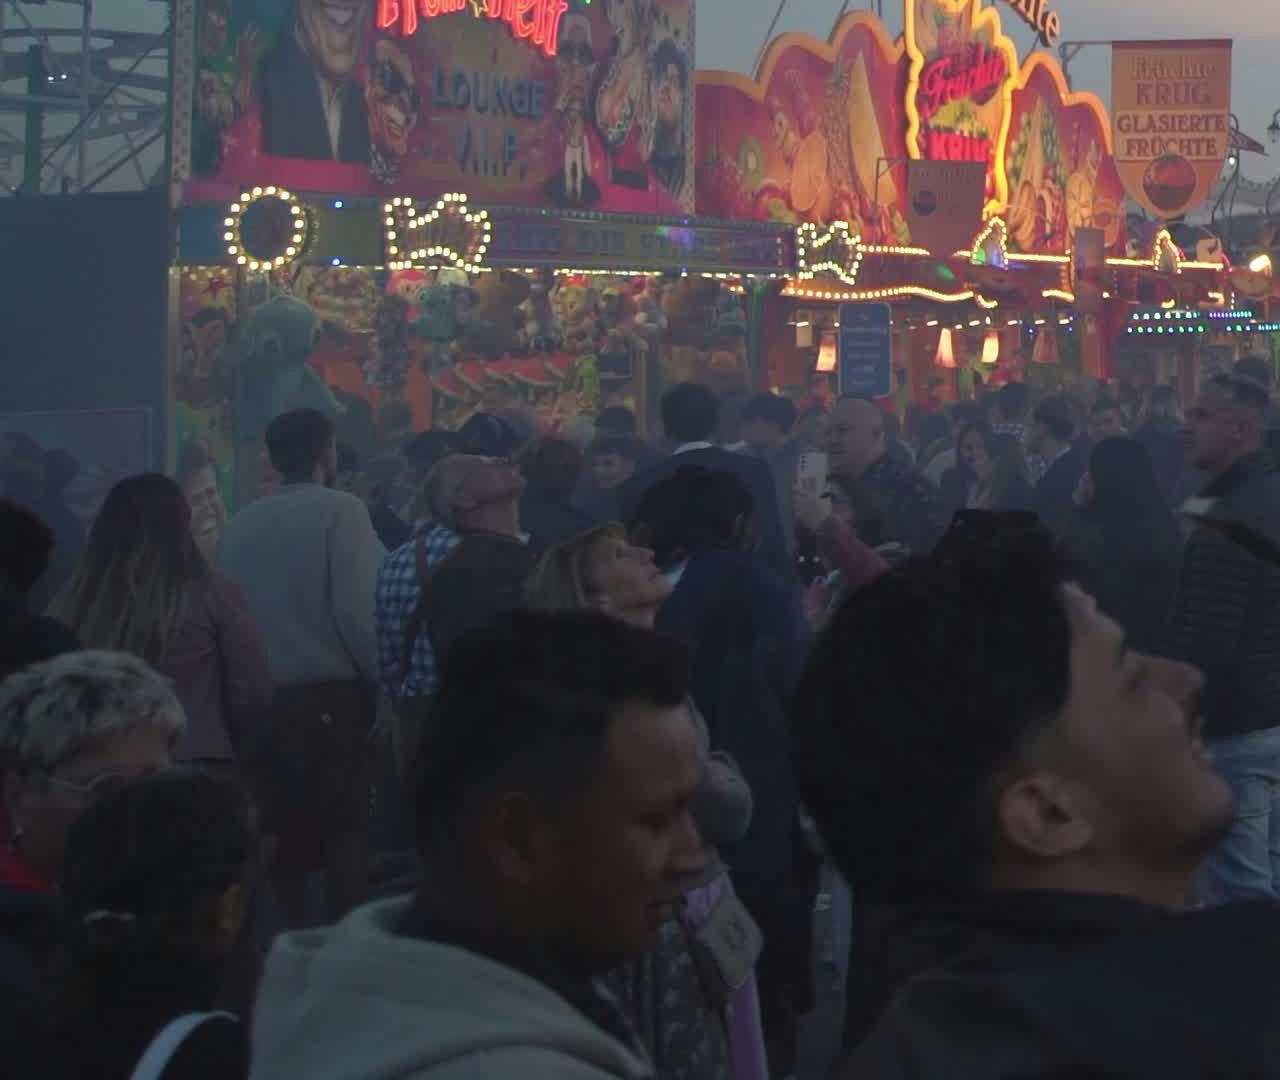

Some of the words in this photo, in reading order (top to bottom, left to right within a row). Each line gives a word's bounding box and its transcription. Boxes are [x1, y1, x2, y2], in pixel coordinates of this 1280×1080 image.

[431, 64, 545, 120] LOUNGE
[1136, 82, 1213, 105] KRUG
[1117, 114, 1227, 134] GLASIERTE
[1125, 135, 1217, 156] FRÜCHTE
